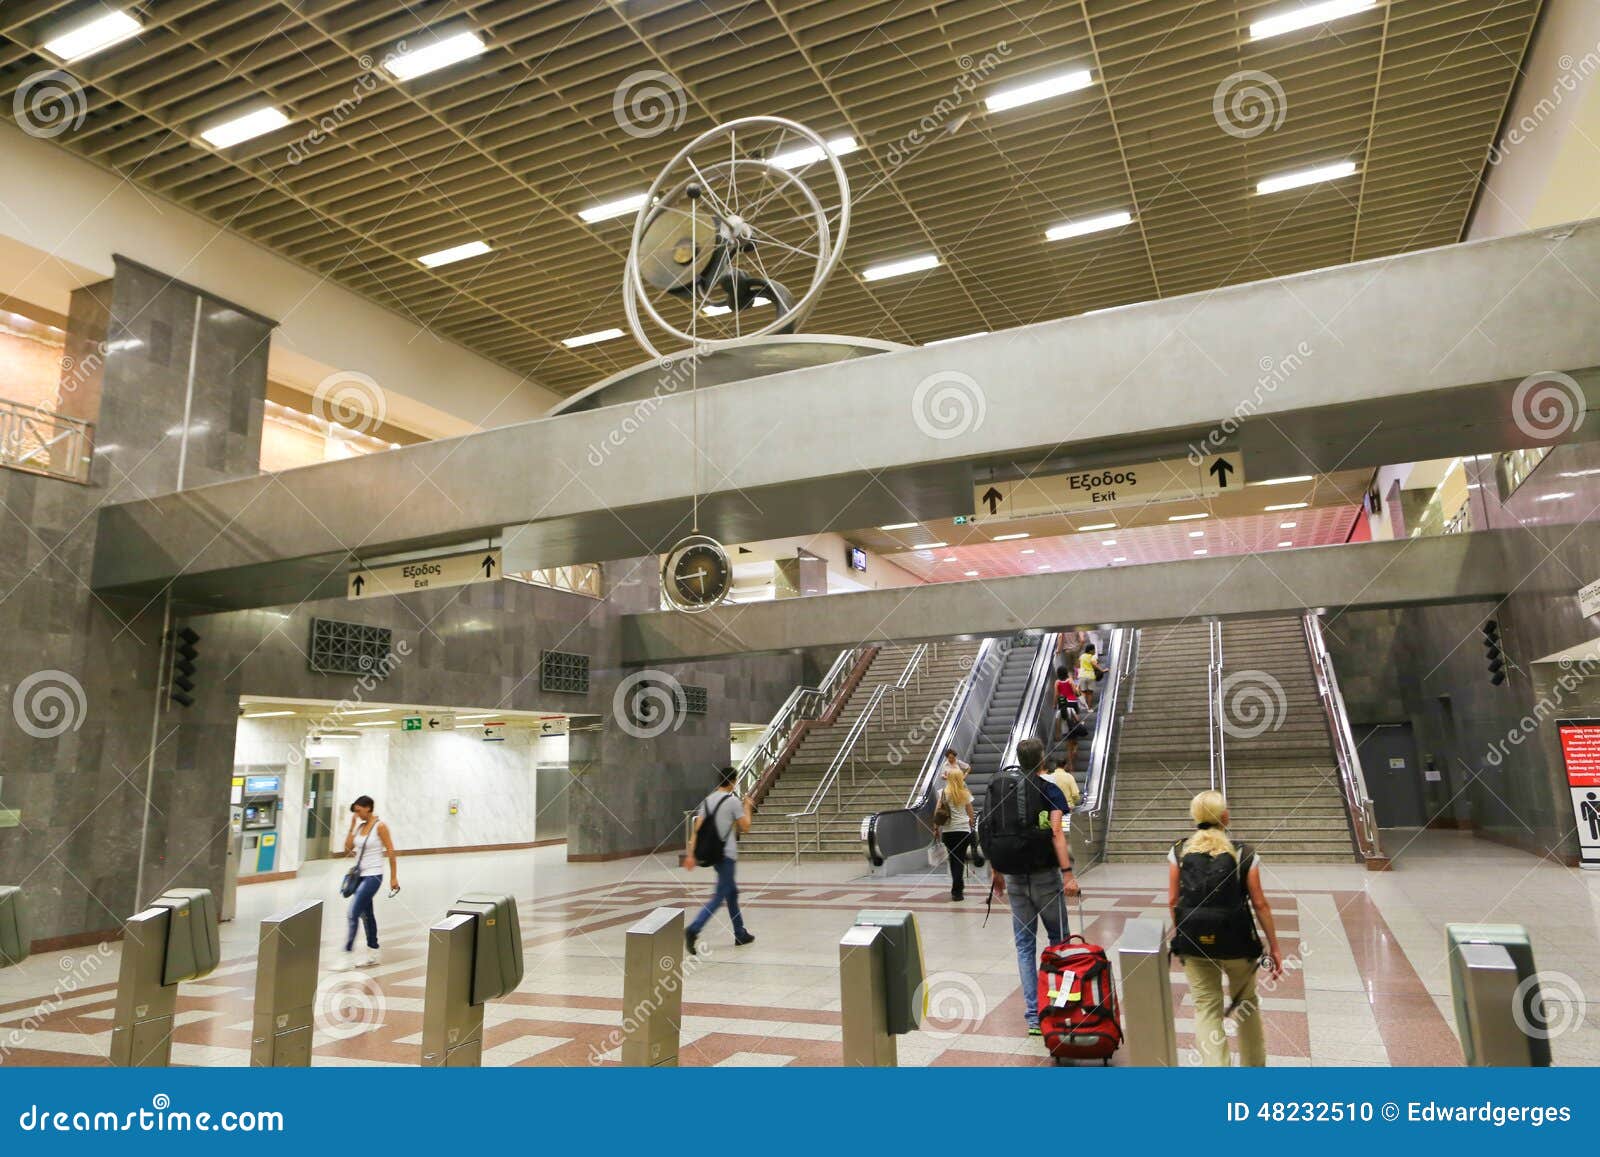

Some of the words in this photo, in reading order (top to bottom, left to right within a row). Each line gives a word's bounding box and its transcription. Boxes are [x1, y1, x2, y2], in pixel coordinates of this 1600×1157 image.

[1066, 471, 1137, 491] Έξοδος
[1092, 491, 1116, 503] Exit
[414, 579, 429, 588] Exit
